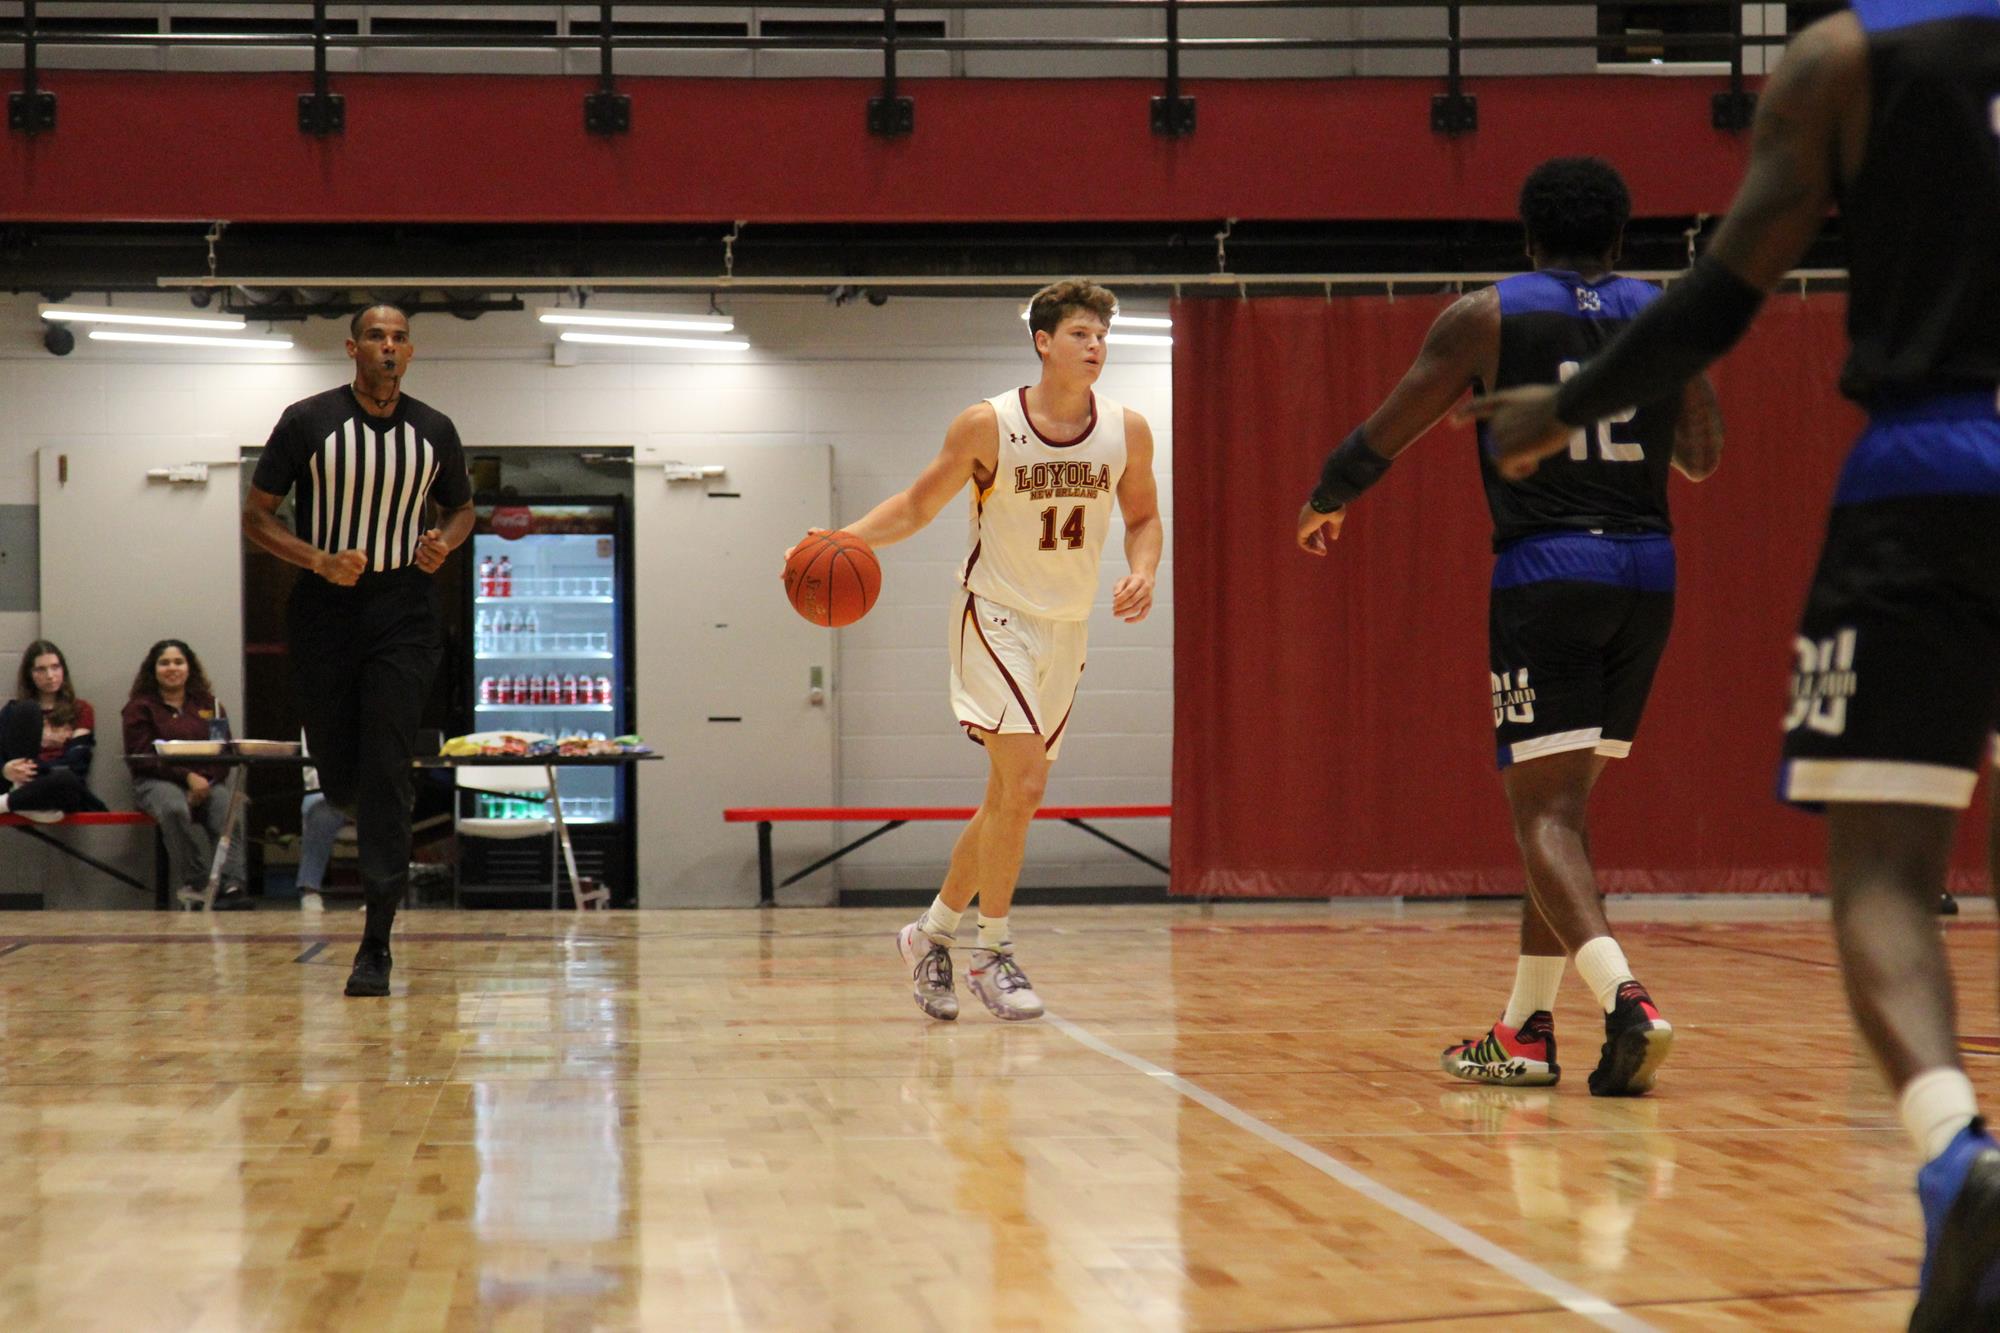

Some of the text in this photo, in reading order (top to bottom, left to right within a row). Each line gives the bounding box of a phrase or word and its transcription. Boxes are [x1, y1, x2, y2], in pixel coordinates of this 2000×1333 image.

[1014, 461, 1111, 494] LOYOLA
[1030, 488, 1098, 501] NEW ORLEANS
[1038, 505, 1085, 551] 14
